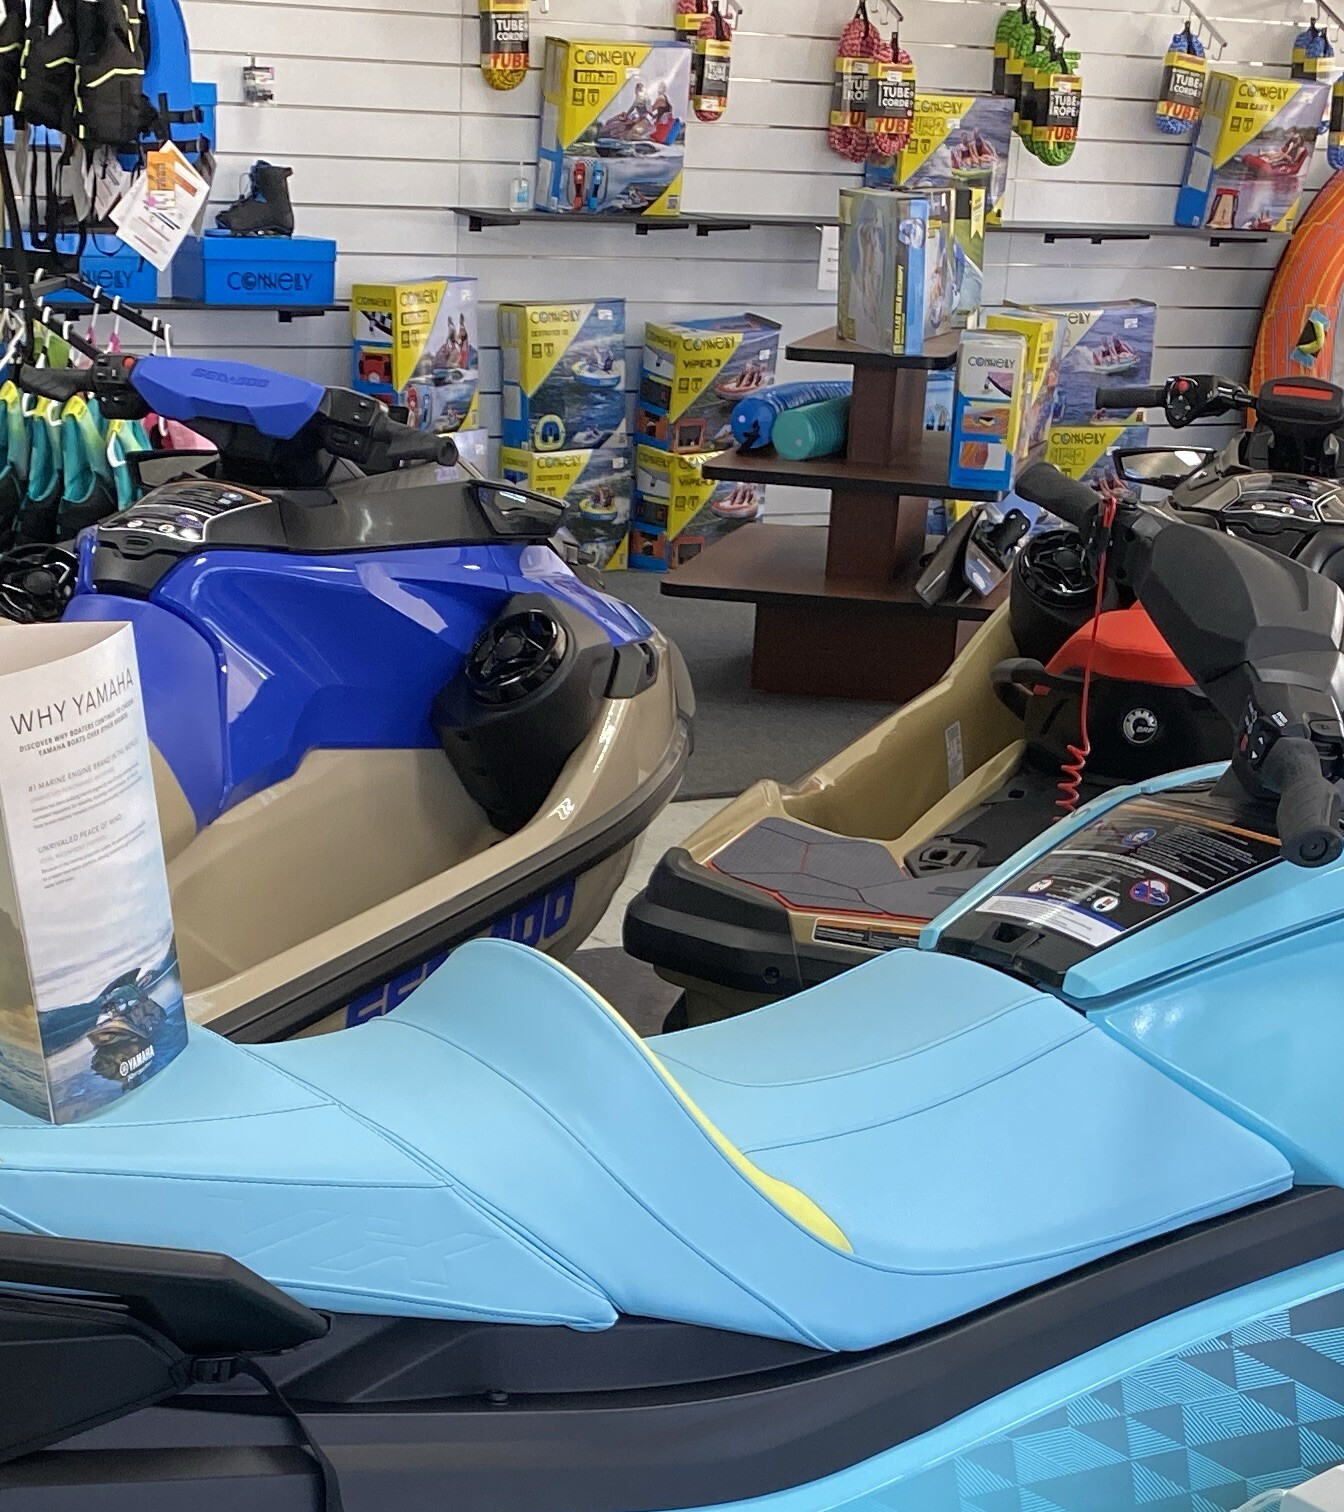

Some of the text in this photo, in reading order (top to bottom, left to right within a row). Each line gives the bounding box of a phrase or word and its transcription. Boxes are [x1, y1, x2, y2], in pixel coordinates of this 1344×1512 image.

[496, 19, 524, 32] TUBE
[883, 85, 911, 98] TUBE
[1175, 73, 1199, 88] TUBE
[10, 699, 66, 735] WHY
[71, 667, 134, 717] YAMAHA
[18, 737, 53, 753] DISCOVER
[53, 731, 69, 743] WHY
[69, 721, 95, 736] BOATERS
[38, 742, 66, 757] YAMAHA
[66, 736, 86, 748] BOATS
[86, 730, 101, 741] OVER
[37, 775, 67, 790] MARINE
[67, 764, 93, 779] ENGINE
[37, 834, 79, 854] UNRIVALED
[79, 825, 100, 839] PEACE
[127, 1044, 155, 1071] YAMAHA
